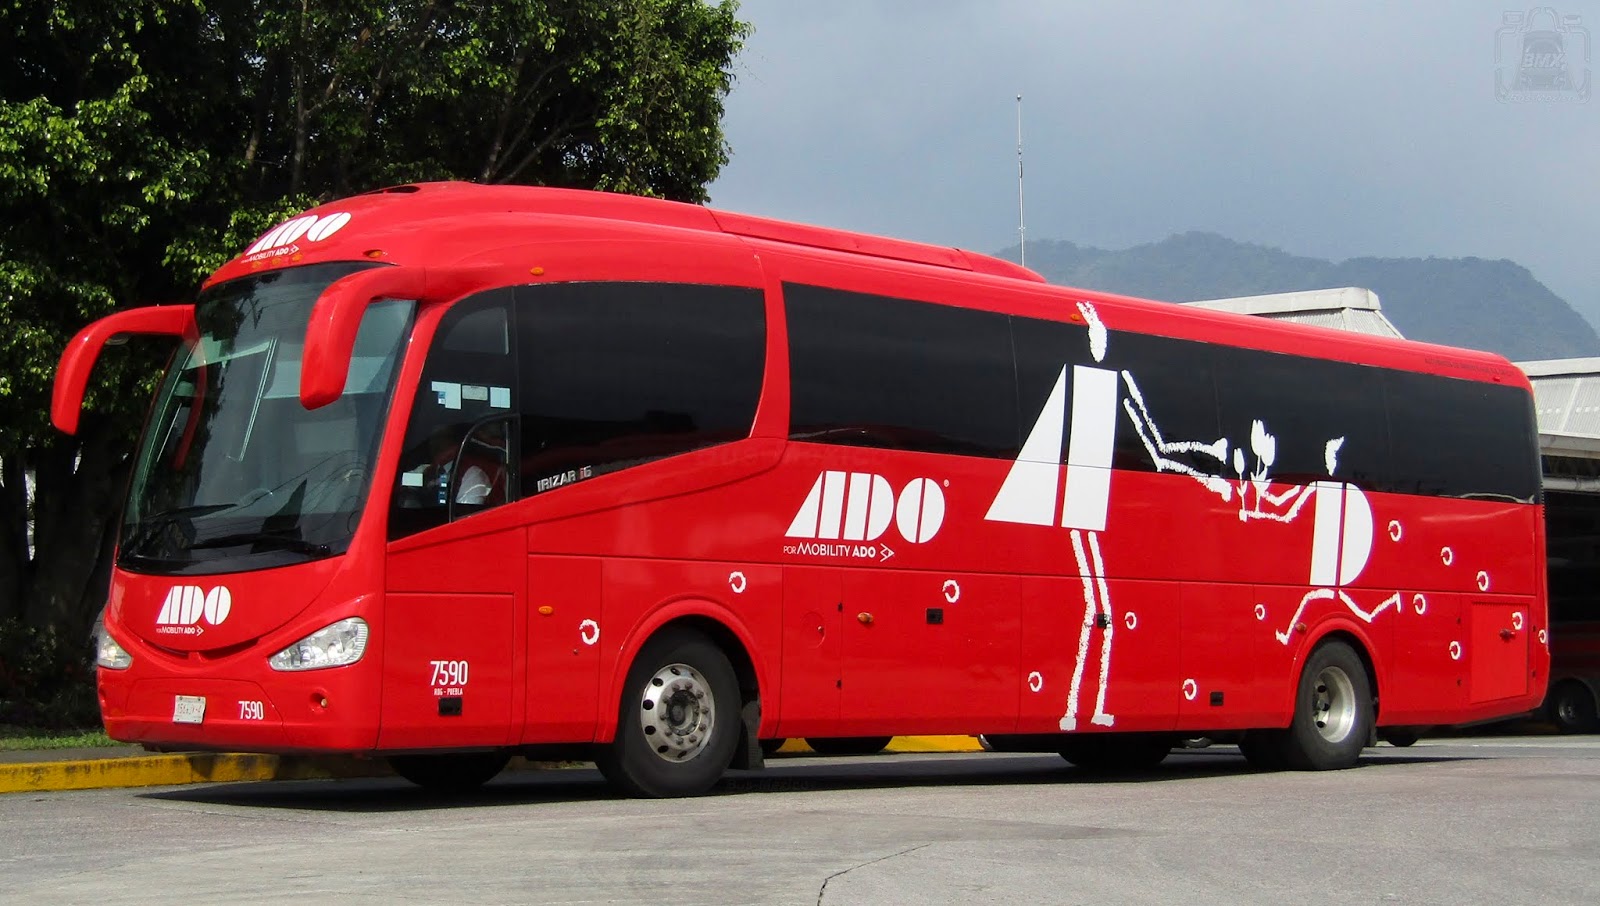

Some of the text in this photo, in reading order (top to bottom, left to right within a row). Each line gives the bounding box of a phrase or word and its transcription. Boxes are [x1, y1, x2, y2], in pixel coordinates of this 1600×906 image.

[246, 212, 352, 256] ADO
[249, 250, 276, 262] MOBILITY
[275, 247, 289, 257] ADO
[537, 470, 576, 492] IRIZAR
[784, 470, 945, 544] ADO
[783, 542, 877, 559] POR MOBILITY ADO
[156, 585, 232, 625] ADO
[162, 626, 184, 634] MOBILITY
[184, 627, 196, 635] ADO
[430, 660, 468, 686] 7590
[238, 700, 264, 720] 7590
